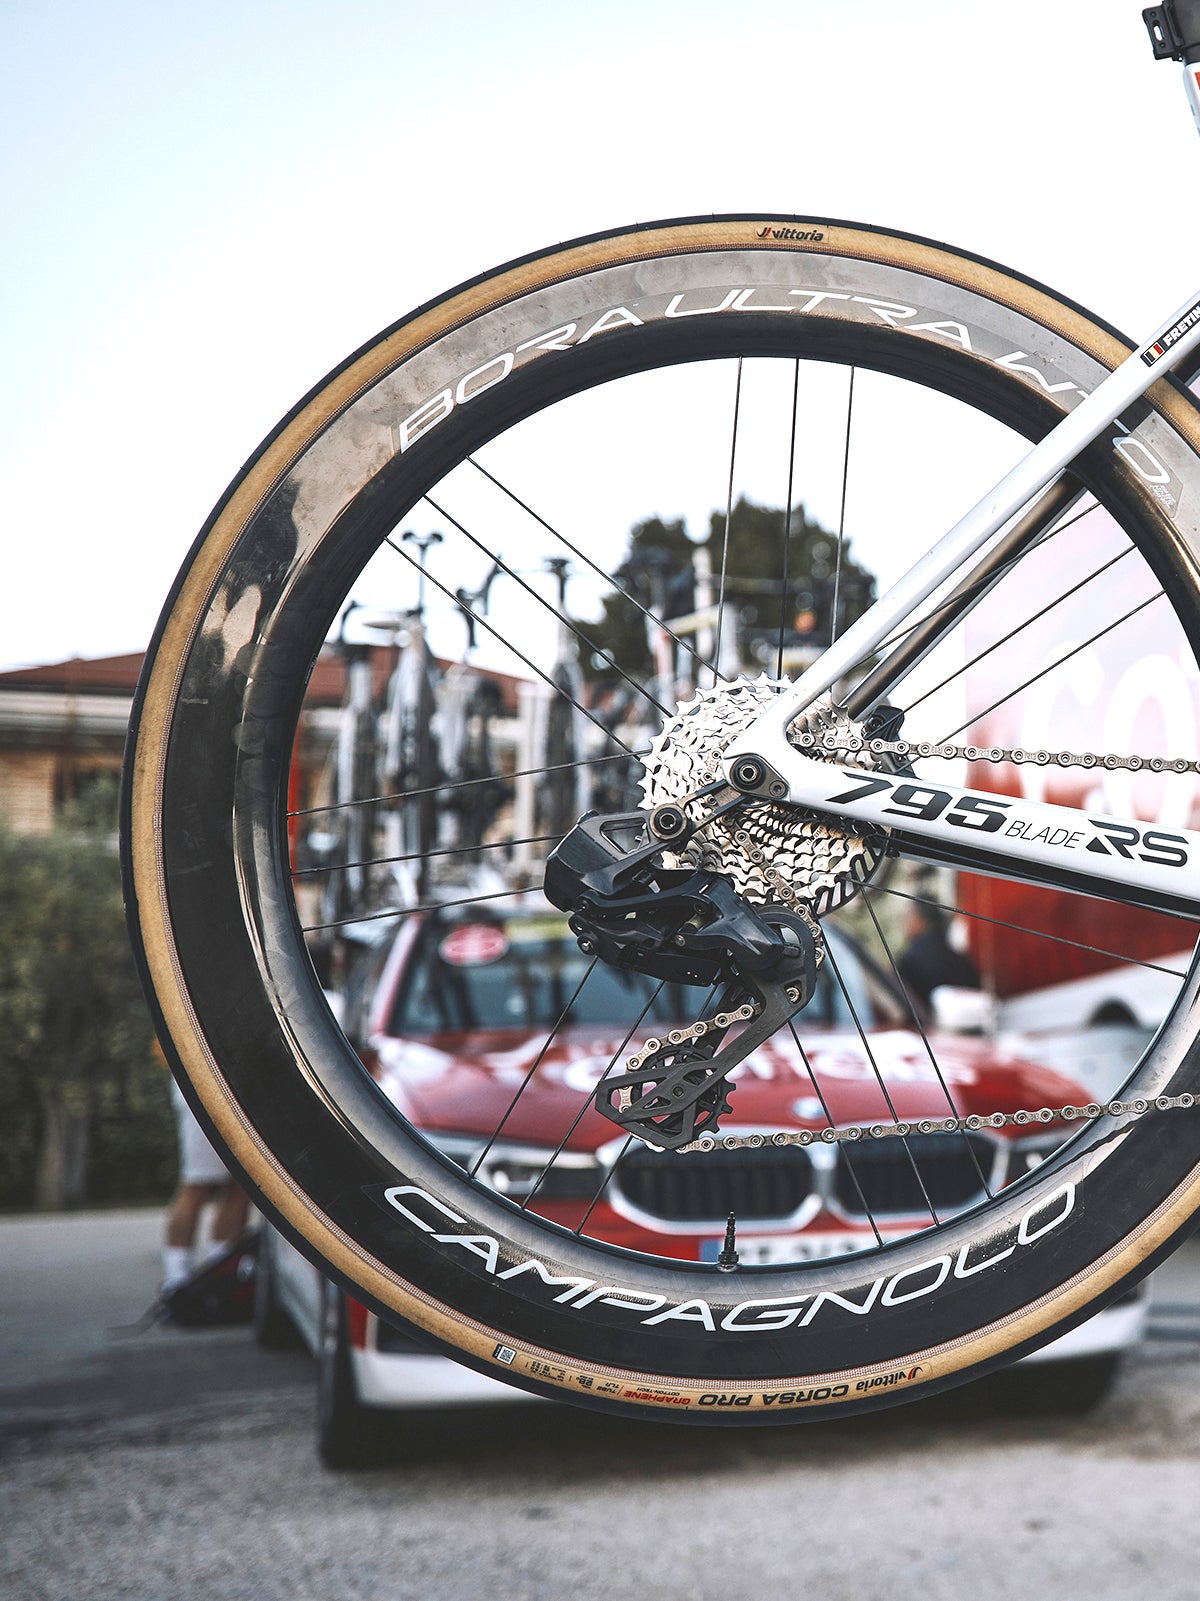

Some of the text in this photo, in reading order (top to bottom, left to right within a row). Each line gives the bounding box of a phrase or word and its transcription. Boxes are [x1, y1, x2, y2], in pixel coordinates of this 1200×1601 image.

[771, 227, 824, 242] vittoria
[400, 288, 1171, 484] BORA ULTRA WO
[825, 772, 1190, 868] 795 BLADE RS
[384, 1180, 1077, 1332] CAMPAGNOLO
[623, 1390, 691, 1405] GRAPHENE
[697, 1369, 909, 1408] vittoria CORSA PRO
